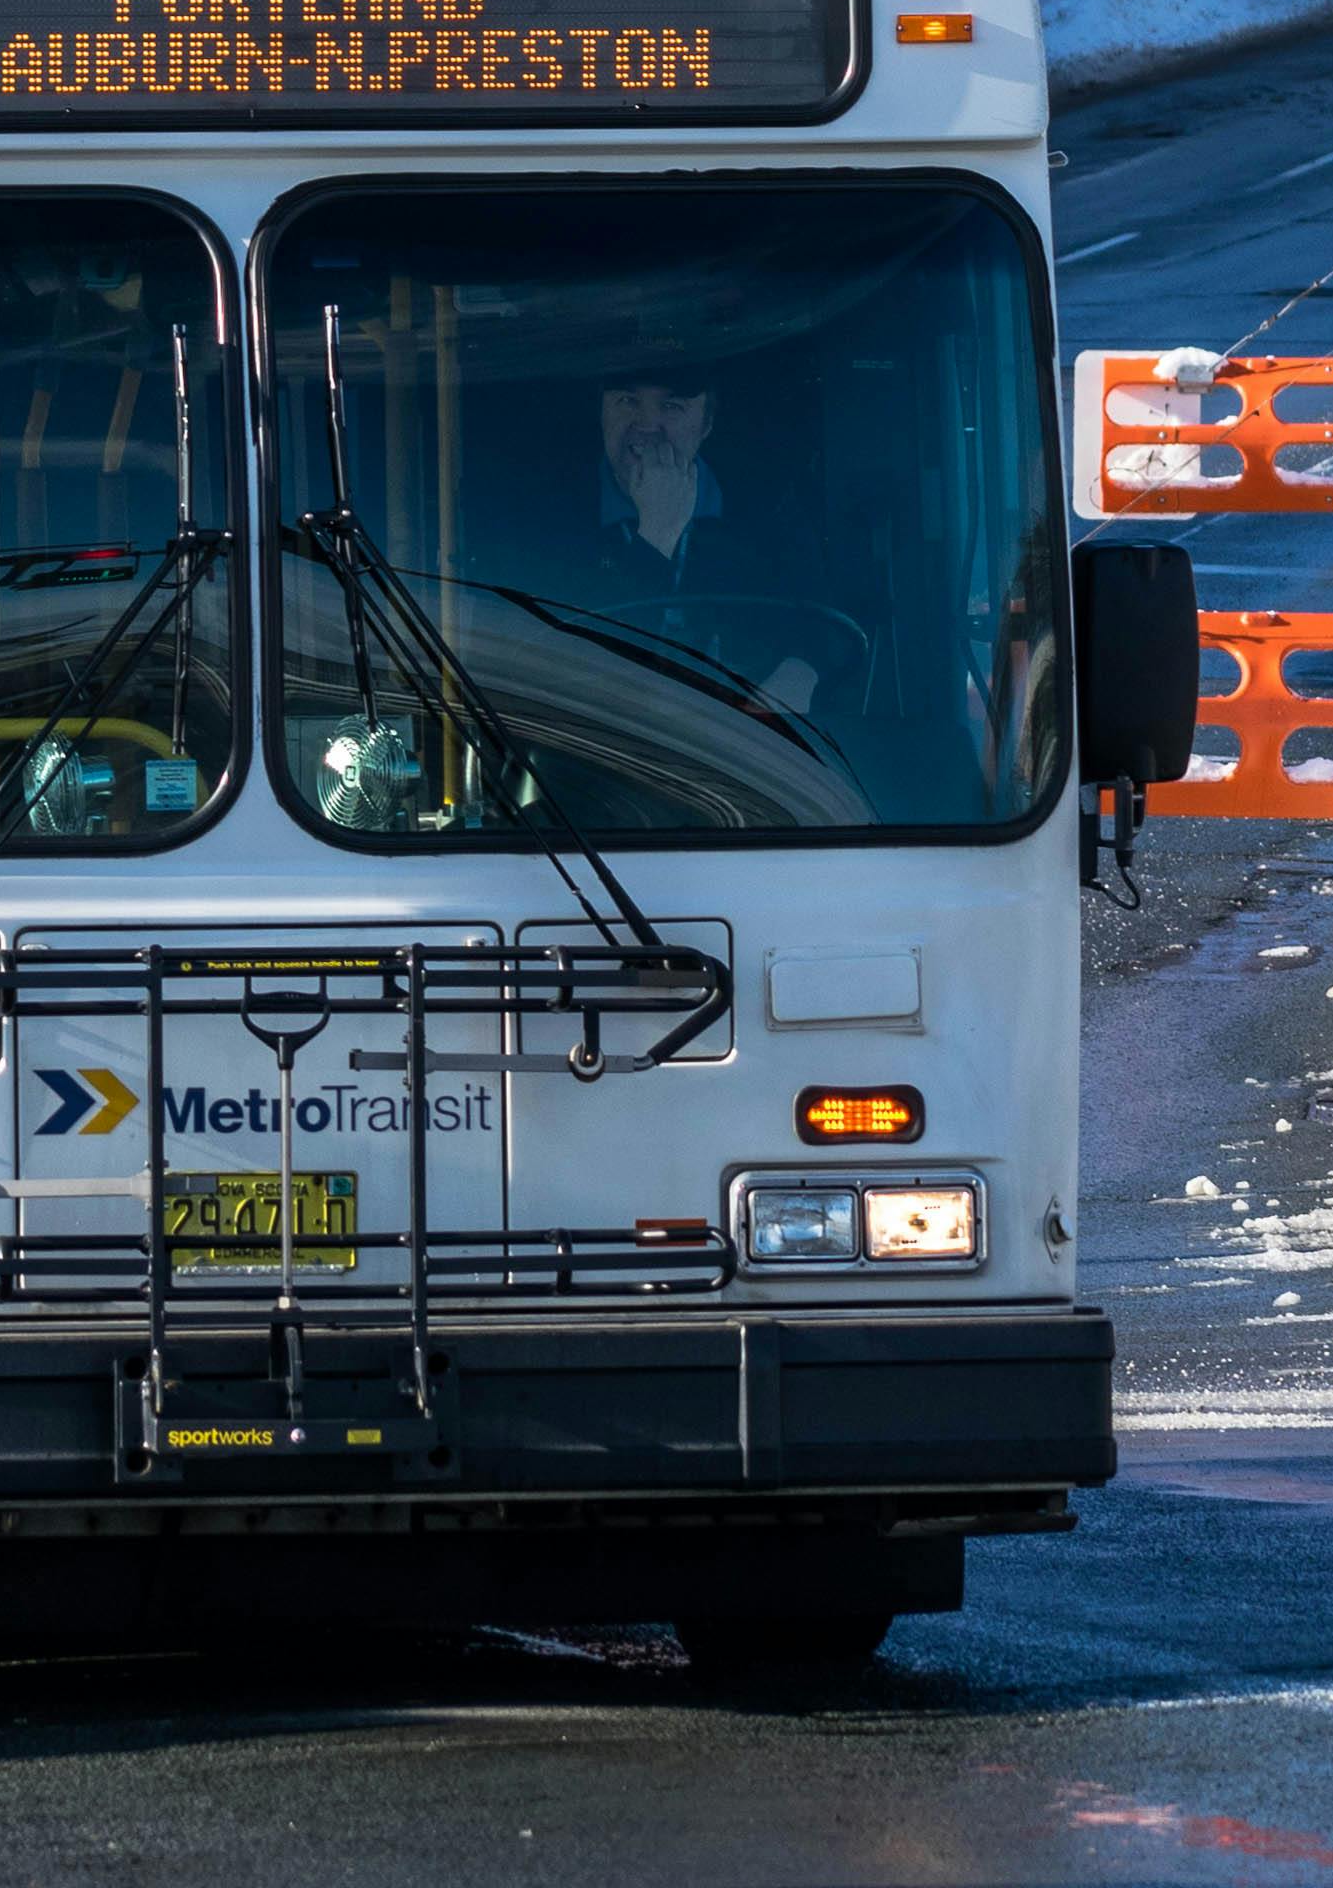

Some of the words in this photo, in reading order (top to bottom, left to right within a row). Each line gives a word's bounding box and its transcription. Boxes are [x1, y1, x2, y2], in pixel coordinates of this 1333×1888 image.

[1, 30, 710, 92] AUBURN-N.PRESTON
[208, 961, 230, 969] Push
[233, 961, 252, 969] rack
[255, 961, 271, 969] and
[273, 961, 310, 970] squeeze
[311, 959, 342, 968] handle
[344, 959, 353, 967] to
[355, 959, 380, 967] lower
[168, 1428, 274, 1447] sportworks
